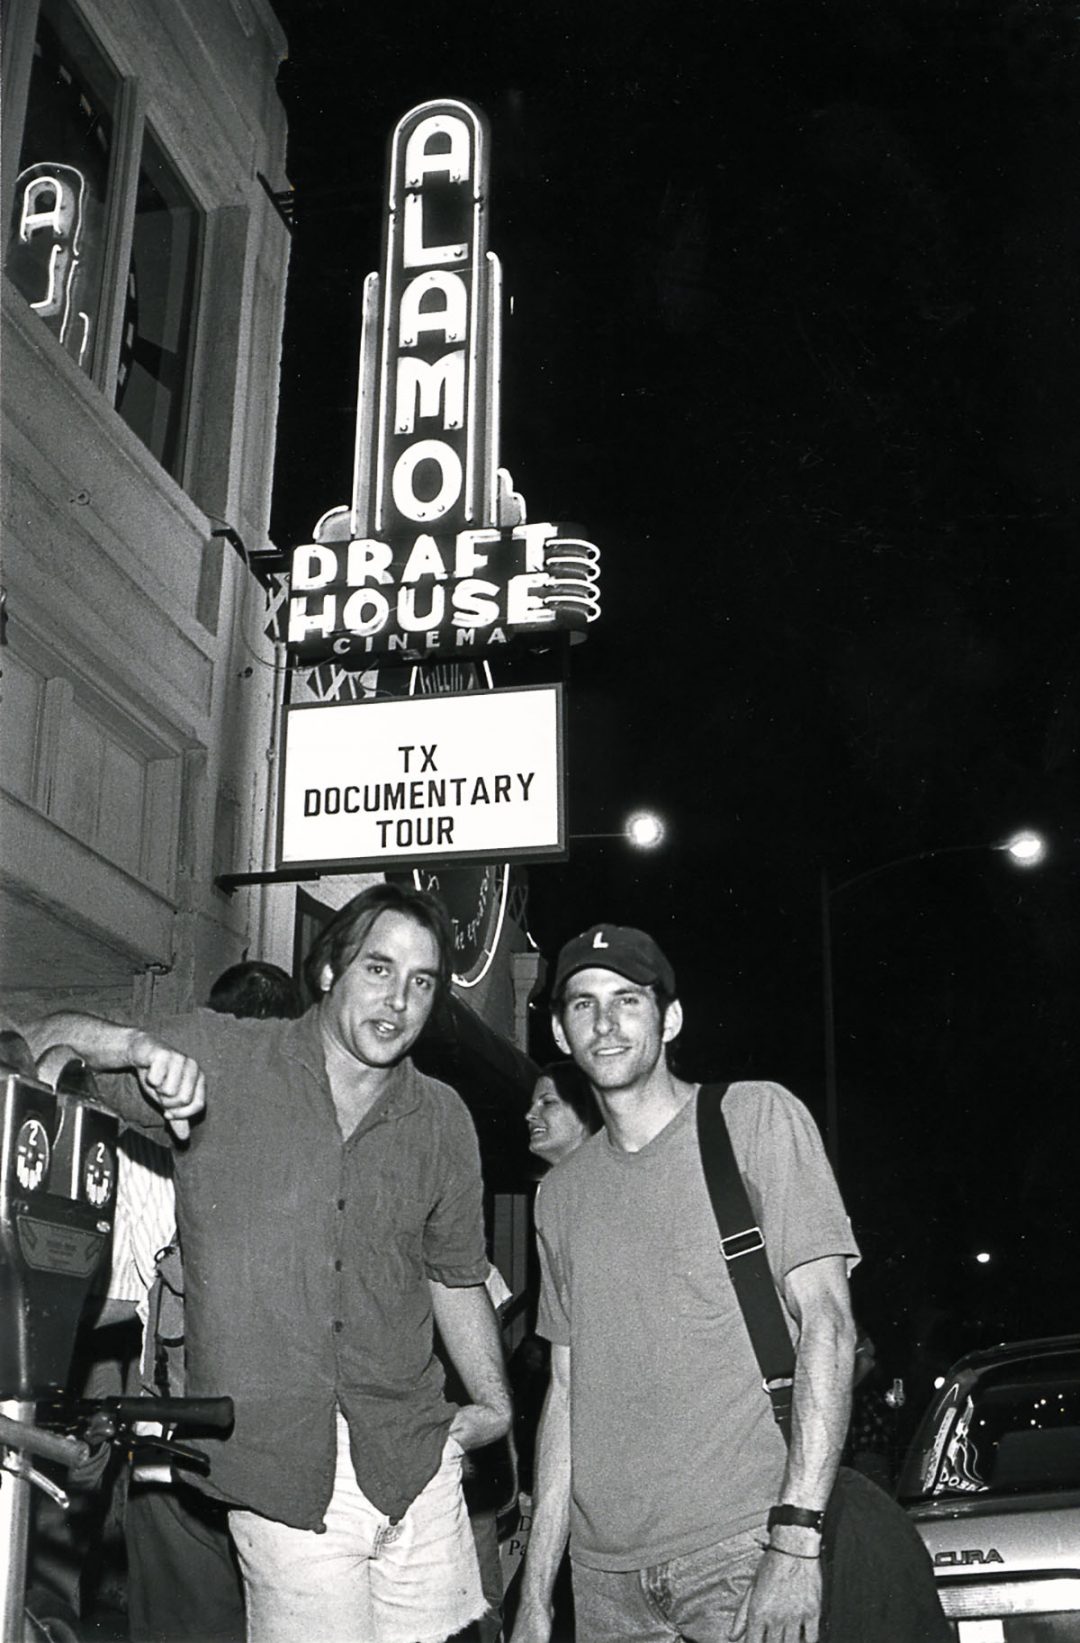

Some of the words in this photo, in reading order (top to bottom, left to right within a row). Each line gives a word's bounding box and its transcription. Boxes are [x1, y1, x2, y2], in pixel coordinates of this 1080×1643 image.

[392, 114, 470, 522] ALAMO
[291, 522, 559, 591] DRAFT
[288, 572, 557, 643] HOUSE
[332, 626, 508, 655] CINEMA
[398, 744, 438, 773] TX
[303, 772, 535, 818] DOCUMENTARY
[376, 816, 455, 848] TOUR
[593, 931, 609, 948] L
[933, 1548, 1005, 1567] CURA
